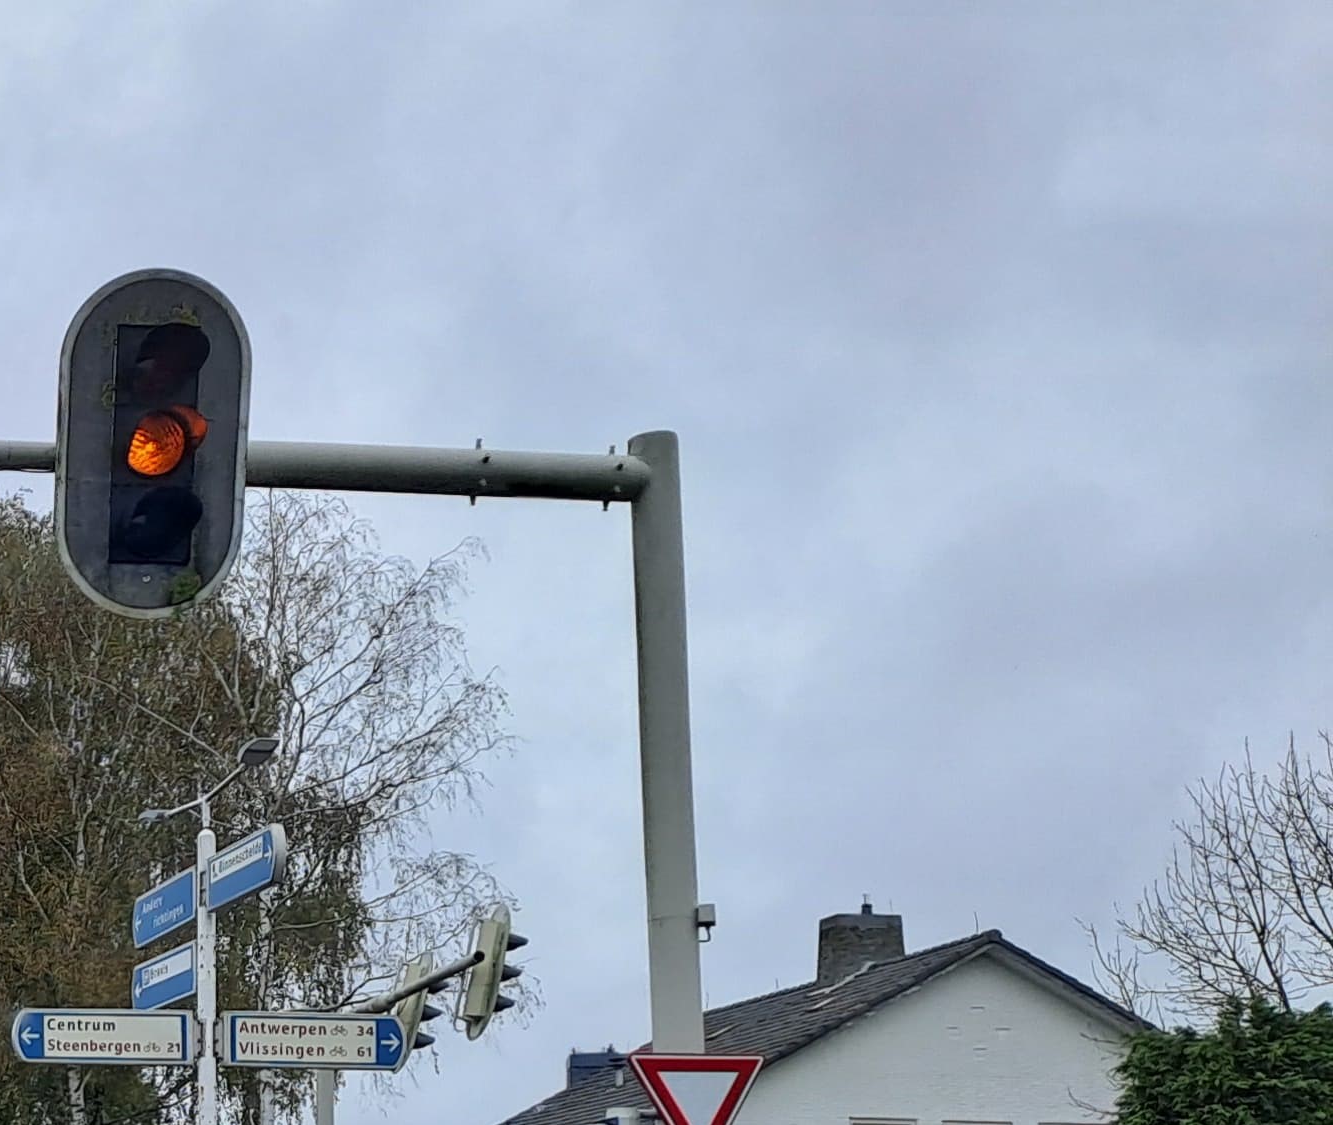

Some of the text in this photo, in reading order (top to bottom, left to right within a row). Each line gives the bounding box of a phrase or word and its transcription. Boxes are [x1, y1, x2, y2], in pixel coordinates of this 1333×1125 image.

[47, 1017, 116, 1032] Centrum
[239, 1020, 374, 1038] Antwerpen 34
[47, 1038, 181, 1055] Steenbergen 21
[239, 1041, 373, 1060] Vlissingen 61
